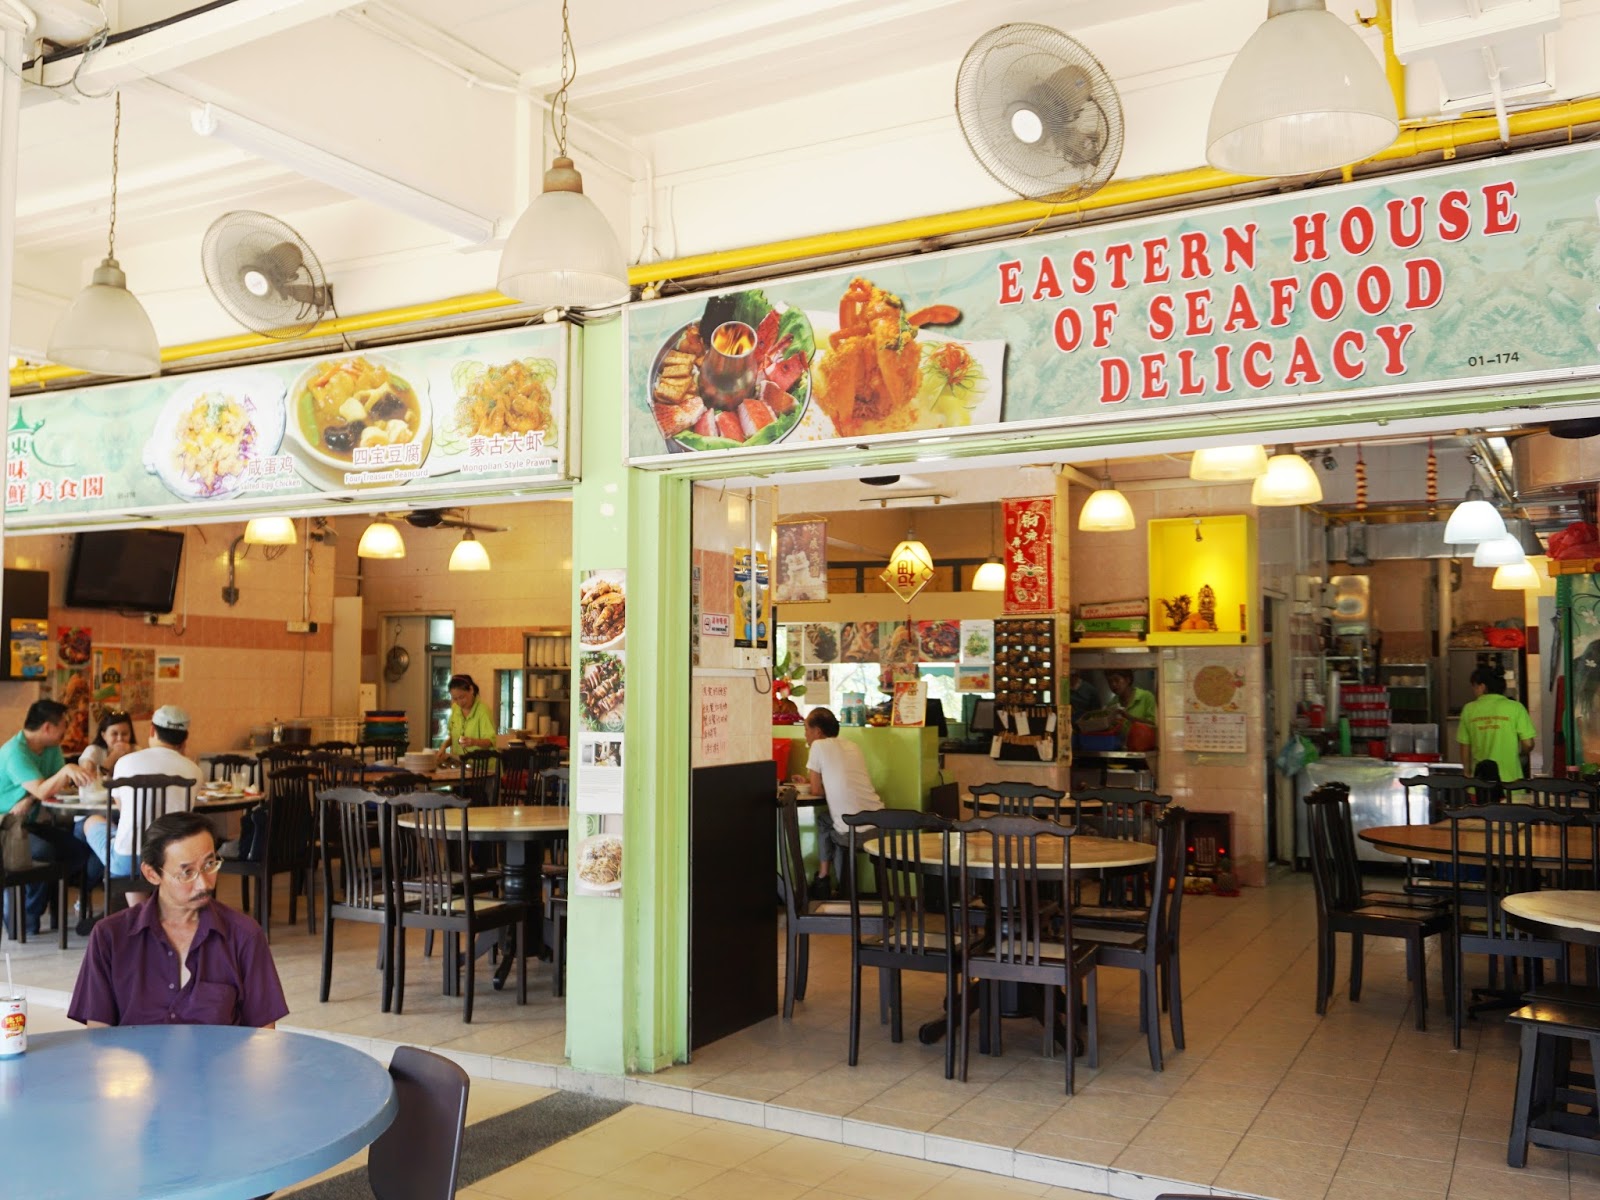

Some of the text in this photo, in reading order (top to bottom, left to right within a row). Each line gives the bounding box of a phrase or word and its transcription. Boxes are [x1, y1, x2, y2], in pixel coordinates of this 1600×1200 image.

[999, 222, 1258, 305] EASTERN
[1292, 180, 1519, 264] HOUSE
[1053, 257, 1443, 352] OF SEAFOOD
[1099, 323, 1414, 404] DELICACY
[1468, 351, 1520, 367] 01-174
[354, 444, 421, 466] 四宝豆腐
[470, 432, 543, 457] 蒙古大虾
[248, 456, 294, 477] 咸蛋鸡
[345, 469, 429, 484] Four Treasure Beancurd
[462, 459, 551, 473] Mongolian Style Prawn
[274, 479, 301, 488] Chicken
